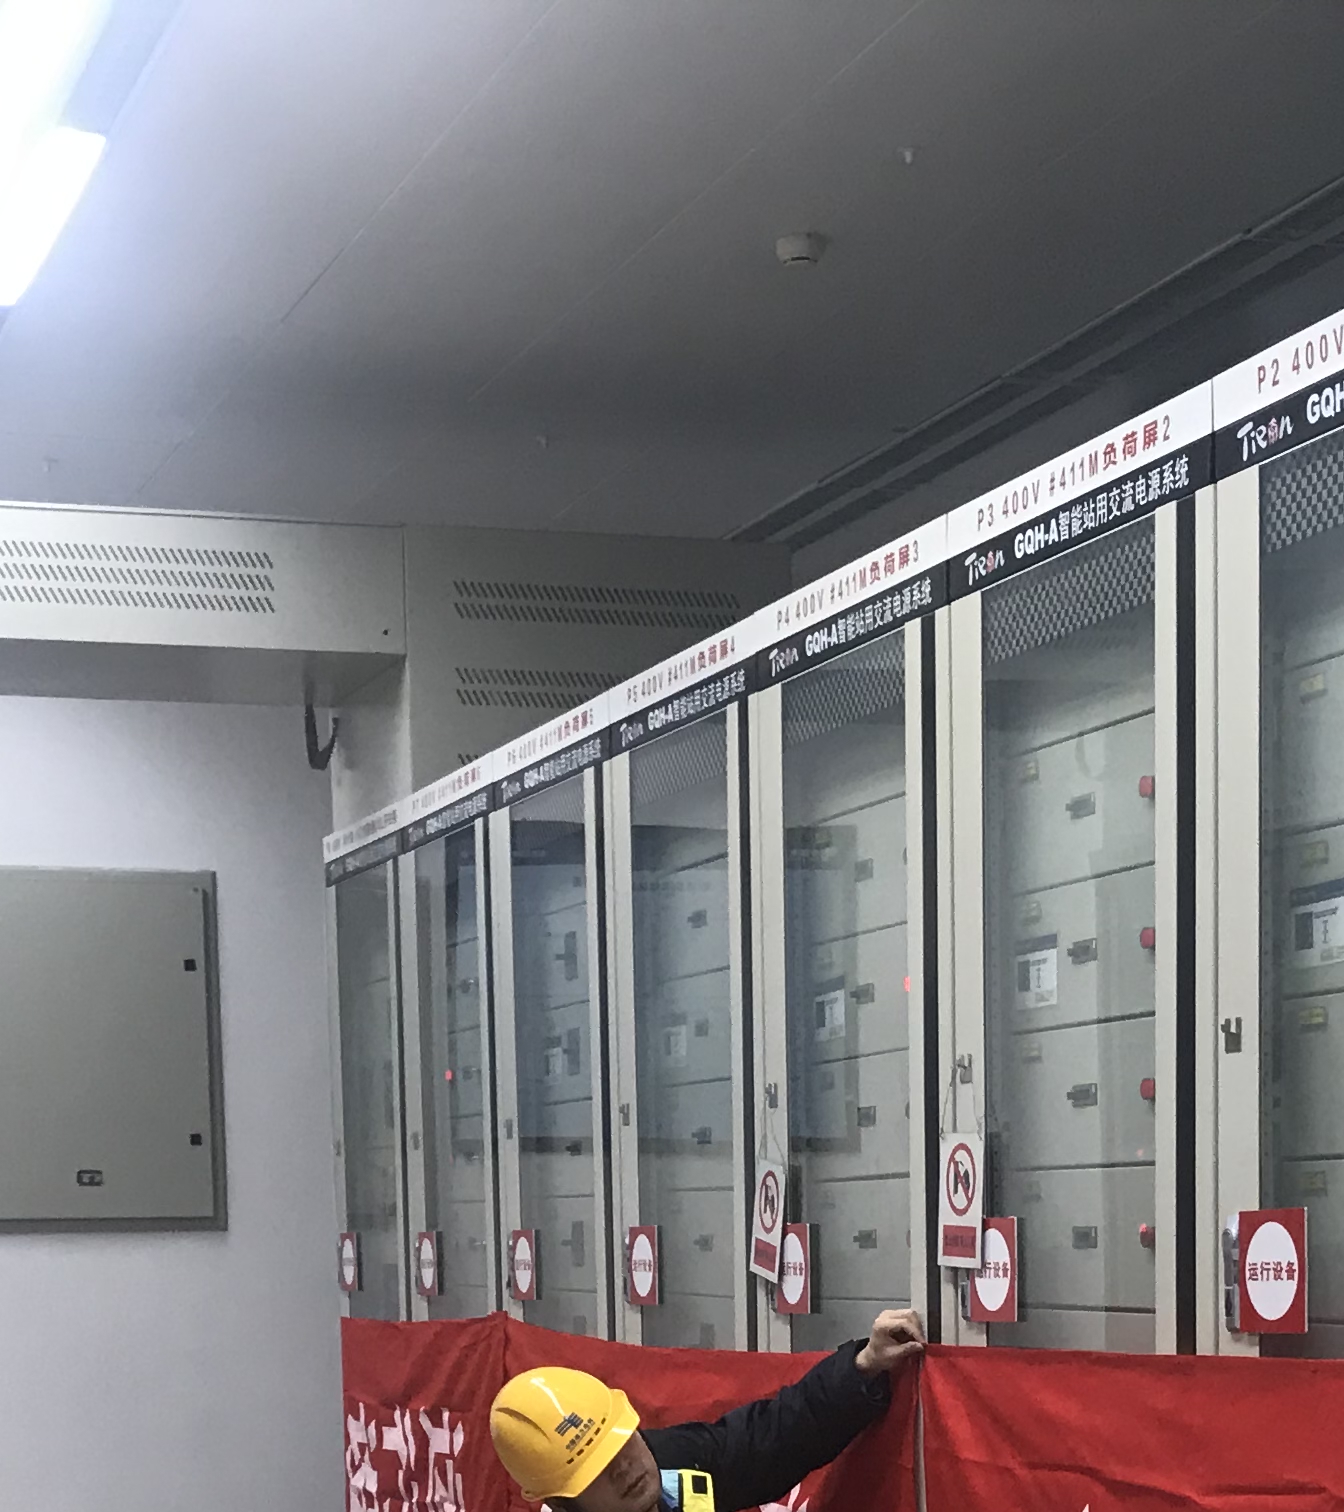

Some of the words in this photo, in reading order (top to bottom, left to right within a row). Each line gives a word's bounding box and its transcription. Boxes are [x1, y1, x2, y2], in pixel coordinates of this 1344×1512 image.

[1257, 358, 1280, 395] P2
[977, 503, 996, 532] P3
[1001, 479, 1042, 519] 400V
[1048, 415, 1172, 498] #411M负荷屏2
[1014, 452, 1190, 560] GQH-A智能站用交流电源系统
[777, 606, 791, 631] P4
[795, 590, 825, 621] 400V
[830, 541, 920, 605] #411M负荷屏3
[1247, 1260, 1297, 1282] 运行设备
